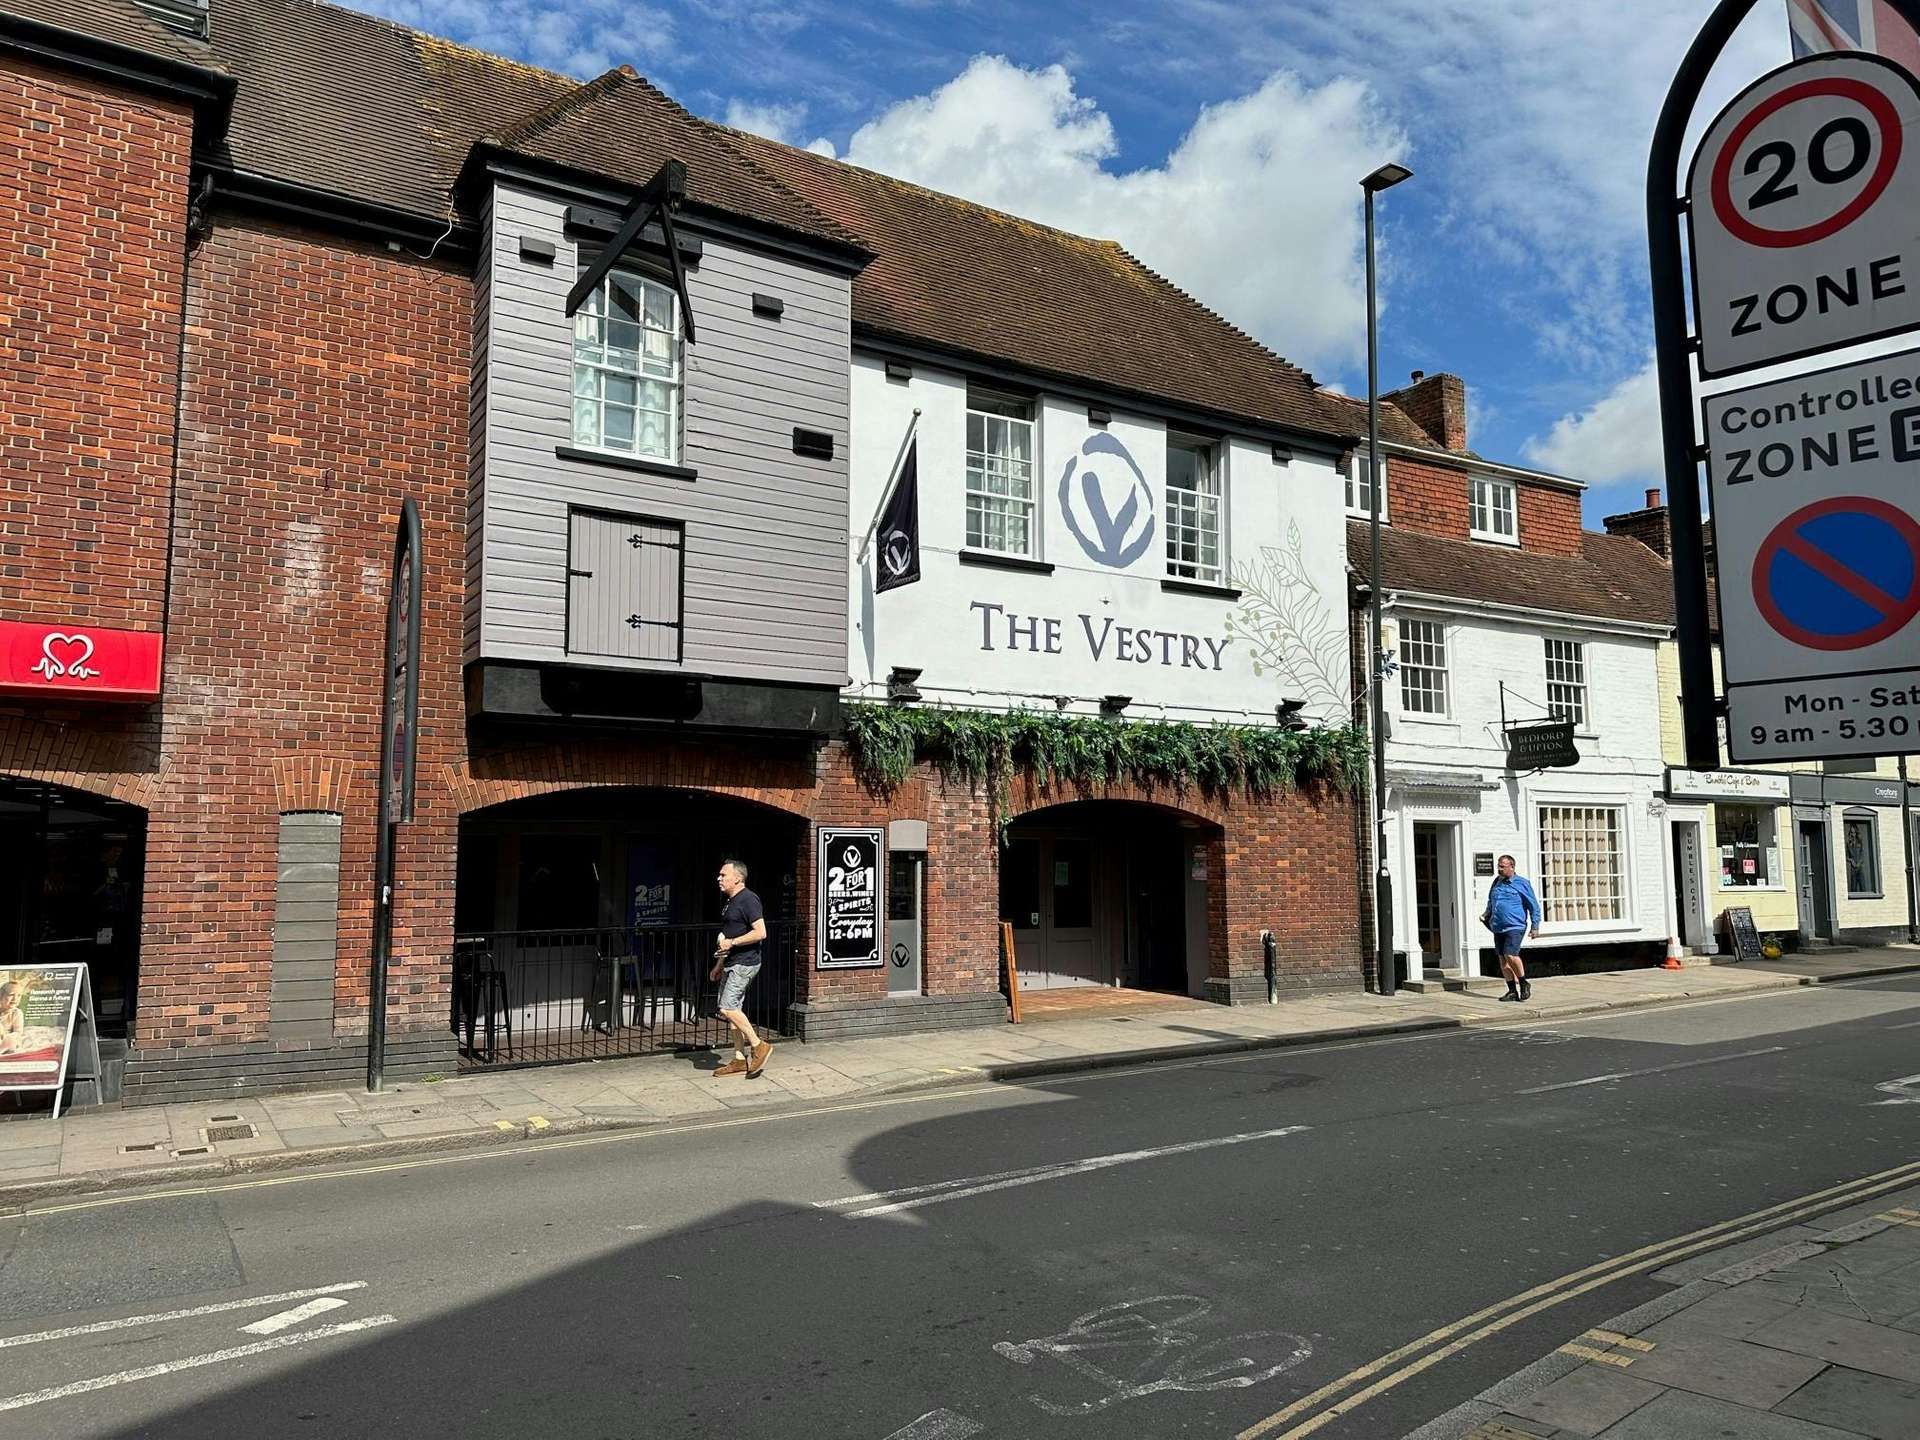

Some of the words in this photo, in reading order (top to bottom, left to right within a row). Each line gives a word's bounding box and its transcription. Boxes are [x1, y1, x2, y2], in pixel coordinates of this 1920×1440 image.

[1743, 116, 1871, 211] 20
[1729, 254, 1906, 338] ZONE
[1720, 375, 1920, 434] Controlle
[1725, 423, 1879, 486] ZONE
[969, 600, 1063, 655] THE
[1078, 613, 1230, 671] VESTRY
[1784, 694, 1844, 714] Mon
[1869, 685, 1920, 708] Sat
[1519, 731, 1564, 744] BEDFORD
[1750, 725, 1767, 745] 9
[1774, 727, 1814, 743] am
[1839, 715, 1909, 739] 5.30
[828, 866, 845, 891] 2
[846, 870, 864, 888] FOR
[864, 866, 874, 891] 1
[838, 897, 872, 912] SPIRITS
[828, 915, 874, 930] Everyday
[829, 927, 873, 940] 12-6PM
